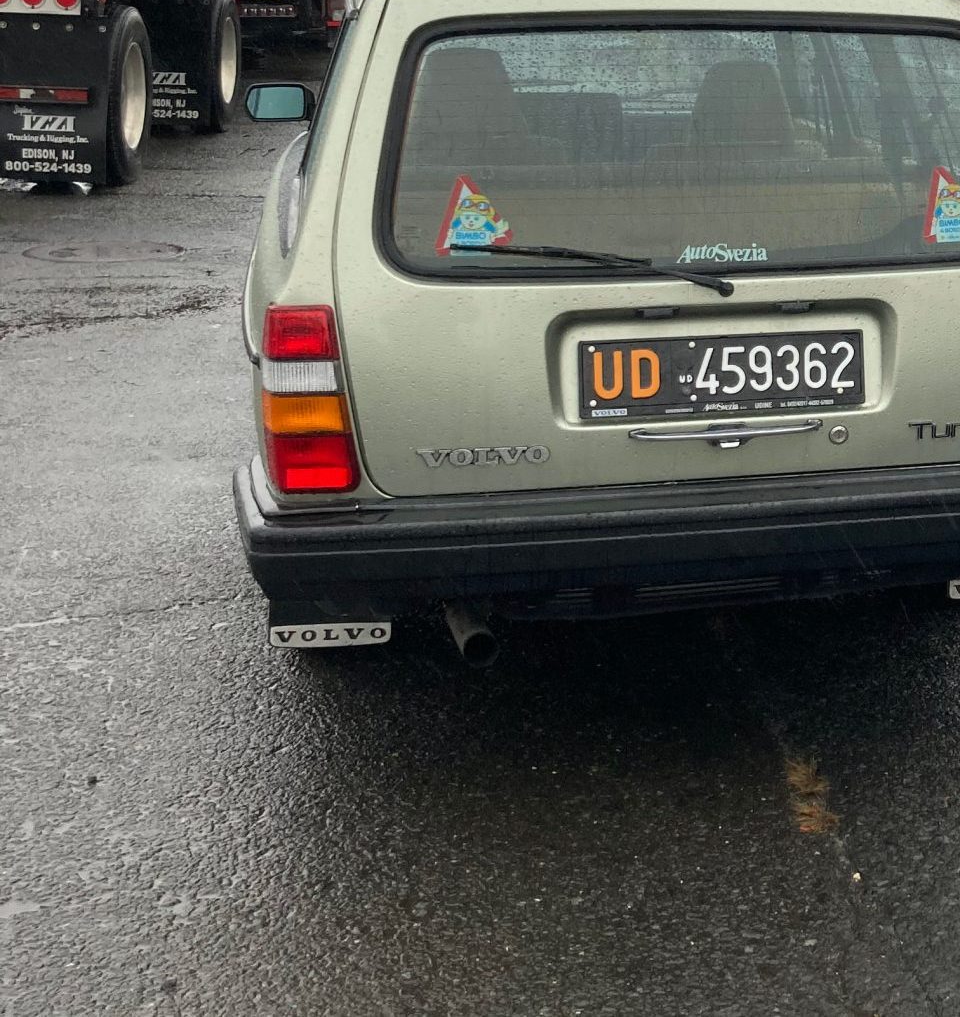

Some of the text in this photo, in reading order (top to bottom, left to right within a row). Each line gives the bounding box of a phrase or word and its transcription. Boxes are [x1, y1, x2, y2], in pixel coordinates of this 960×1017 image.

[152, 71, 187, 86] ZZI
[175, 98, 186, 108] NJ
[22, 114, 76, 132] IZZI
[7, 133, 39, 143] Trucking
[47, 134, 76, 144] Rigging,
[76, 135, 89, 144] Inc.
[22, 148, 75, 162] EDISON, NJ
[5, 160, 92, 174] 800-524-1439
[676, 243, 769, 264] AutoSvezia
[593, 341, 855, 400] UD UD 459362
[416, 444, 551, 468] VOLVO
[275, 627, 387, 643] VOLVO
